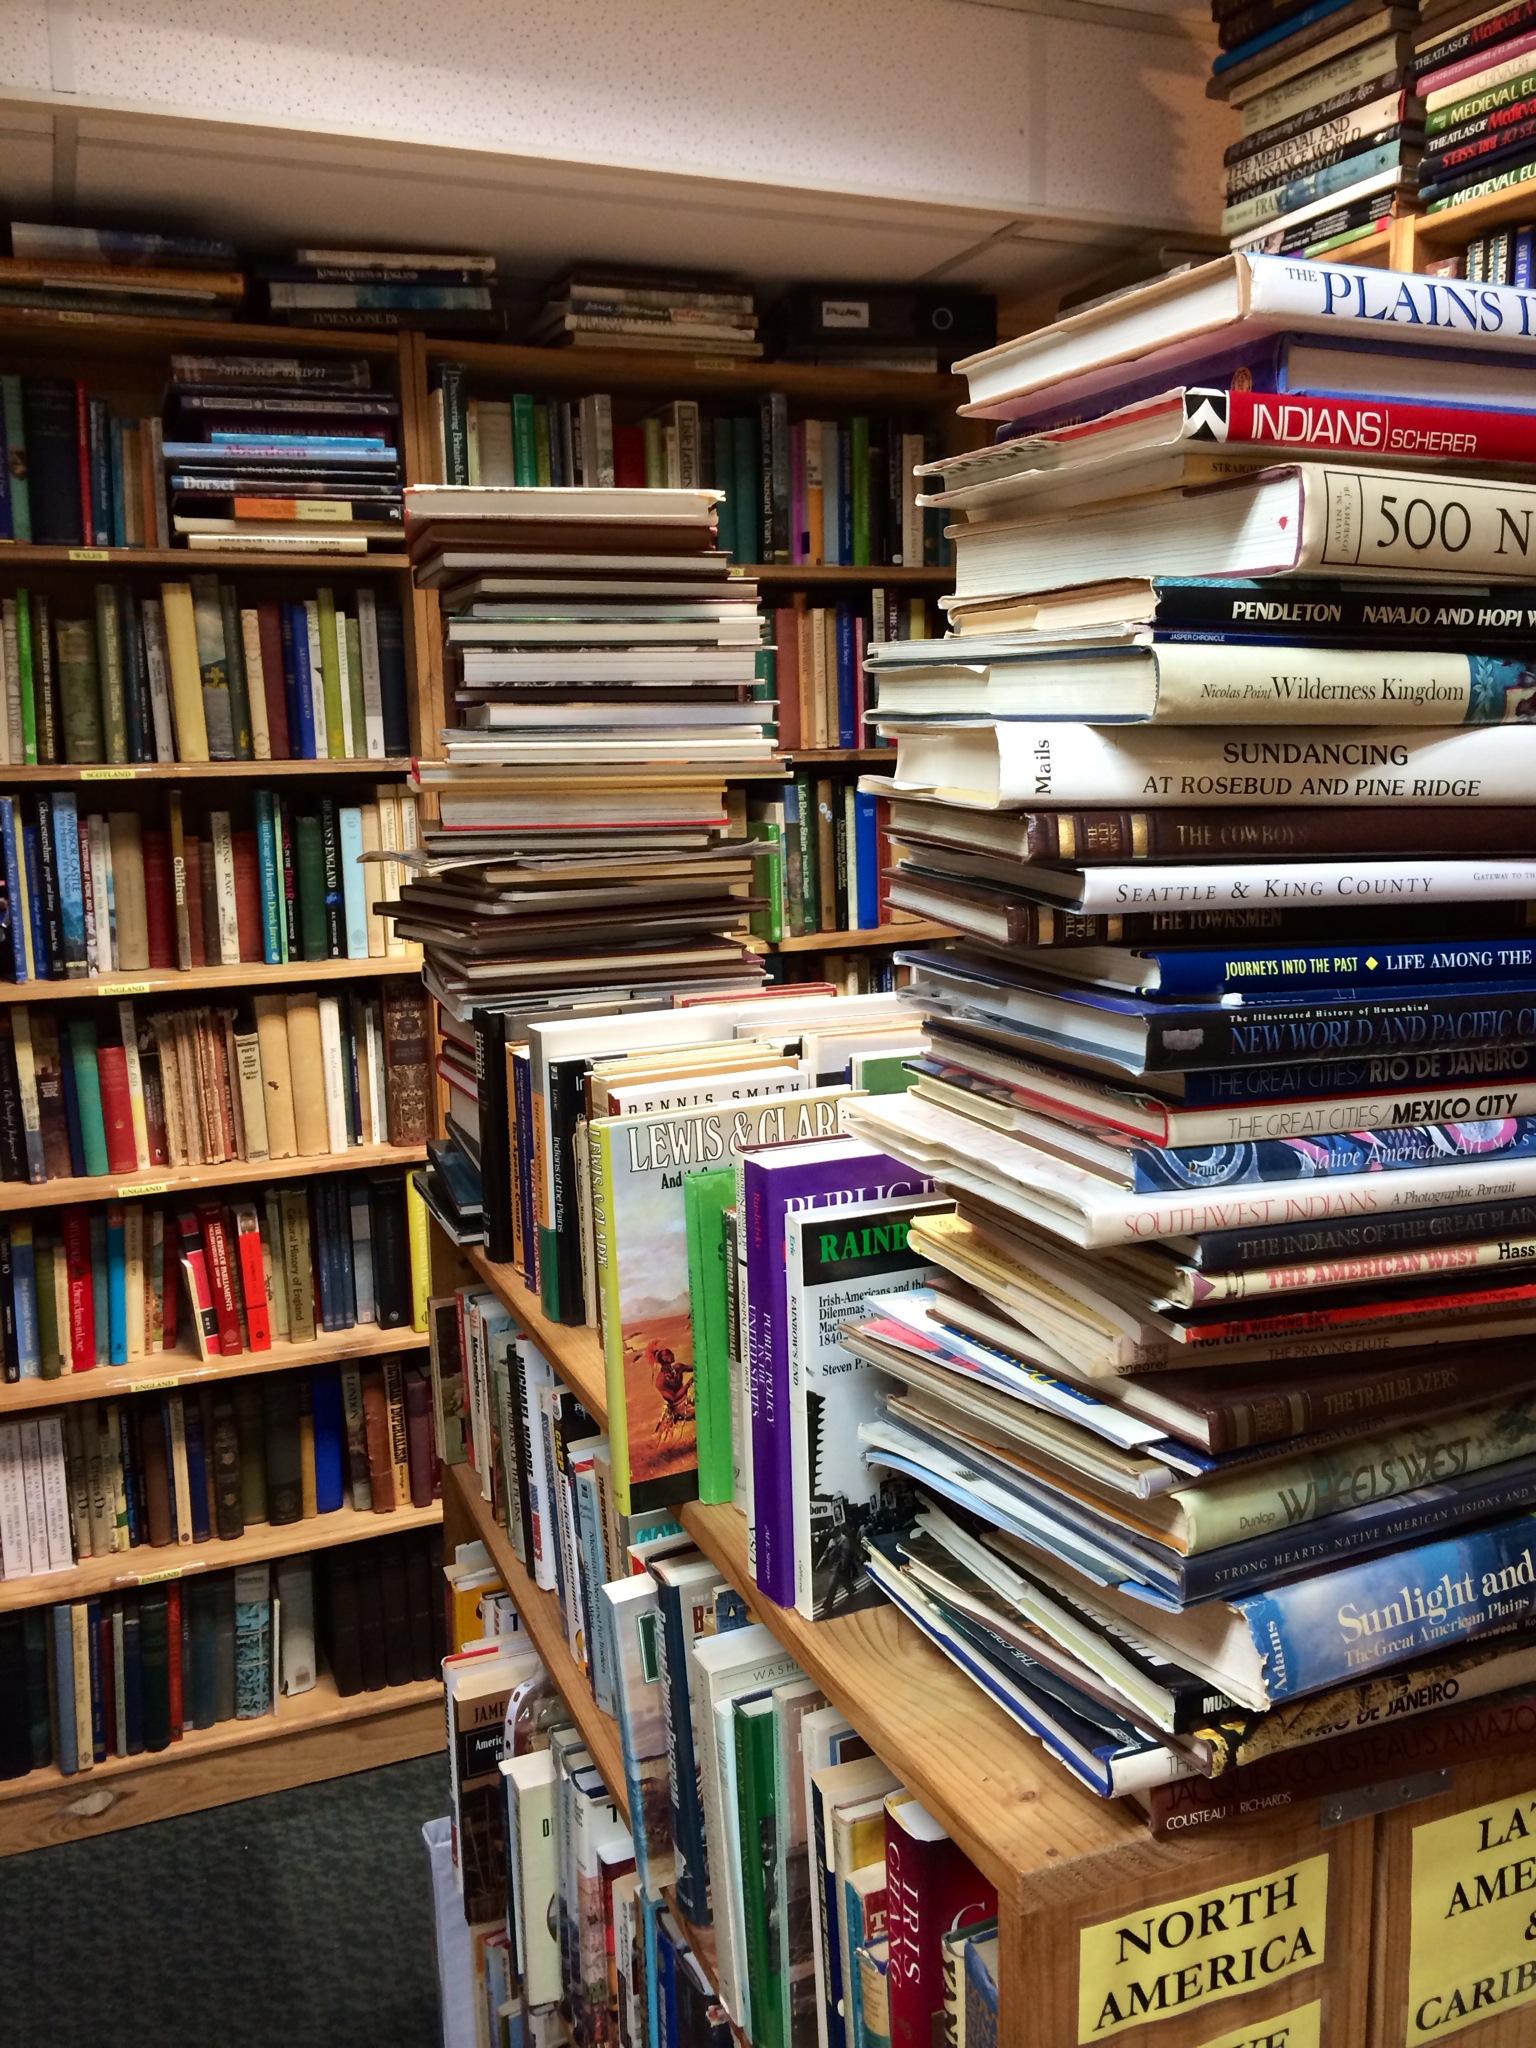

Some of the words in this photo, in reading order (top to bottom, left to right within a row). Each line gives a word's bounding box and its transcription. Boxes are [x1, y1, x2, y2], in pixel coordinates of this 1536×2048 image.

[1451, 85, 1519, 124] MEDIEVAL
[1252, 134, 1317, 172] MEDIEVAL
[1320, 116, 1351, 146] AND
[1285, 266, 1318, 283] THE
[1318, 270, 1505, 333] PLAINS
[1250, 403, 1383, 448] INDIANS
[1389, 427, 1478, 454] SCHERER
[1376, 494, 1472, 553] 500
[1231, 600, 1343, 623] PENDLETON
[1362, 604, 1431, 625] NAVAJO
[1434, 607, 1475, 626] AND
[1476, 608, 1523, 628] HOPI
[1169, 632, 1194, 642] JASPER
[1193, 633, 1226, 643] CHRONICLE
[1200, 682, 1241, 700] Nicolas
[1242, 684, 1272, 700] Point
[1270, 675, 1377, 701] Wilderness
[1382, 677, 1465, 706] Kingdom
[85, 769, 132, 780] SCOTLAND
[1034, 738, 1052, 795] Mails
[1222, 742, 1409, 767] SUNDANCING
[1142, 775, 1174, 795] AT
[1180, 776, 1292, 796] ROSEBUD
[1300, 777, 1349, 797] AND
[1354, 778, 1405, 797] PINE
[1411, 778, 1482, 798] RIDGE
[66, 811, 78, 856] WINDSOR
[1176, 824, 1214, 847] THE
[71, 857, 82, 893] CASTLE
[173, 855, 187, 906] Children
[324, 846, 338, 889] ENGLAND
[1116, 882, 1219, 904] SEATTLE
[1230, 880, 1251, 901] &
[1264, 878, 1324, 900] KING
[1337, 874, 1435, 897] COUNTY
[1151, 911, 1184, 932] THE
[1191, 907, 1283, 930] TOWNSMEN
[1224, 959, 1280, 981] JOURNEYS
[1281, 958, 1307, 976] INTO
[1308, 957, 1331, 975] THE
[1333, 956, 1358, 974] PAST
[1385, 953, 1426, 972] LIFE
[1429, 951, 1494, 969] AMONG
[1497, 949, 1533, 967] THE
[103, 983, 146, 994] ENGLAND
[1229, 1014, 1250, 1023] The
[1253, 1010, 1312, 1022] Illustrated
[1315, 1007, 1355, 1019] History
[1358, 1006, 1370, 1016] of
[1373, 1003, 1430, 1014] Humankind
[1230, 1025, 1287, 1056] NEW
[1288, 1018, 1374, 1051] WORLD
[1376, 1014, 1426, 1045] AND
[1429, 1008, 1513, 1042] PACIFIC
[1209, 1072, 1244, 1098] THE
[1246, 1065, 1304, 1095] GREAT
[1369, 1058, 1409, 1083] RIO
[1415, 1055, 1441, 1080] DE
[1447, 1049, 1530, 1077] JANEIRO
[1227, 1115, 1262, 1140] THE
[1265, 1109, 1326, 1136] GREAT
[1391, 1097, 1472, 1126] MEXICO
[1475, 1093, 1519, 1118] CITY
[552, 1136, 562, 1172] Indians
[589, 1125, 604, 1189] LEWIS
[626, 1116, 725, 1173] LEWIS
[729, 1111, 754, 1157] &
[1299, 1143, 1363, 1173] Native
[1364, 1136, 1447, 1166] American
[1451, 1132, 1484, 1157] Art
[121, 1184, 163, 1196] ENGLAND
[555, 1185, 563, 1201] the
[660, 1172, 683, 1191] And
[555, 1202, 564, 1234] Plains
[1123, 1198, 1276, 1240] SOUTHWEST
[1285, 1188, 1378, 1223] INDIANS
[1390, 1190, 1403, 1206] A
[1403, 1183, 1475, 1208] Photographic
[1475, 1180, 1517, 1199] Portrait
[595, 1205, 609, 1271] CLARK
[1237, 1237, 1279, 1261] THE
[1282, 1226, 1361, 1256] INDIANS
[1362, 1226, 1389, 1247] OF
[1392, 1222, 1427, 1243] THE
[1429, 1214, 1488, 1240] GREAT
[725, 1238, 735, 1293] AMERICAN
[1265, 1268, 1309, 1291] THE
[1312, 1256, 1423, 1287] AMERICAN
[1426, 1246, 1480, 1271] WEST
[818, 1287, 892, 1309] Irish-Americans
[892, 1282, 910, 1295] and
[910, 1278, 926, 1292] the
[818, 1304, 866, 1322] Dilemmas
[728, 1294, 737, 1362] EARTHQUAKE
[748, 1303, 758, 1364] UNITED
[763, 1312, 774, 1371] PUBLIC
[789, 1295, 799, 1364] RAINBOW'S
[1223, 1321, 1248, 1336] THE
[1249, 1316, 1304, 1333] WEEPING
[1306, 1312, 1332, 1327] SKY
[821, 1361, 853, 1378] Steven
[1268, 1349, 1293, 1361] THE
[1294, 1341, 1353, 1360] PRAYING
[1354, 1336, 1390, 1351] FLUTE
[134, 1378, 175, 1391] ENGLAND
[751, 1366, 760, 1419] STATES
[792, 1366, 800, 1387] END
[1323, 1391, 1355, 1417] THE
[1355, 1368, 1460, 1410] TRAILBLAZERS
[515, 1355, 529, 1422] MICHAEL
[522, 1423, 535, 1478] MOORE
[765, 1372, 776, 1429] POLICY
[553, 1429, 565, 1472] CLEP
[1276, 1462, 1397, 1525] WHEELS
[1402, 1436, 1473, 1486] WEST
[560, 1473, 571, 1536] American
[1238, 1511, 1277, 1531] Dunlop
[1213, 1558, 1270, 1584] STRONG
[1273, 1543, 1330, 1568] HEARTS:
[1334, 1528, 1382, 1550] NATIVE
[1384, 1509, 1449, 1536] AMERICAN
[1452, 1494, 1503, 1518] VISIONS
[1504, 1487, 1530, 1506] AND
[140, 1570, 180, 1583] ENGLAND
[1335, 1571, 1480, 1645] Sunlight
[1482, 1547, 1536, 1599] and
[1343, 1646, 1374, 1670] The
[1373, 1634, 1416, 1661] Great
[1416, 1611, 1486, 1645] American
[1487, 1595, 1530, 1622] Plains
[1266, 1619, 1290, 1693] Adams
[1165, 1806, 1227, 1832] COUSTEAU
[1239, 1792, 1292, 1815] RICHARDS
[887, 1839, 903, 1990] CHANG
[902, 1877, 922, 1985] IRIS
[1115, 1872, 1299, 1966] NORTH
[1092, 1925, 1316, 2033] AMERICA
